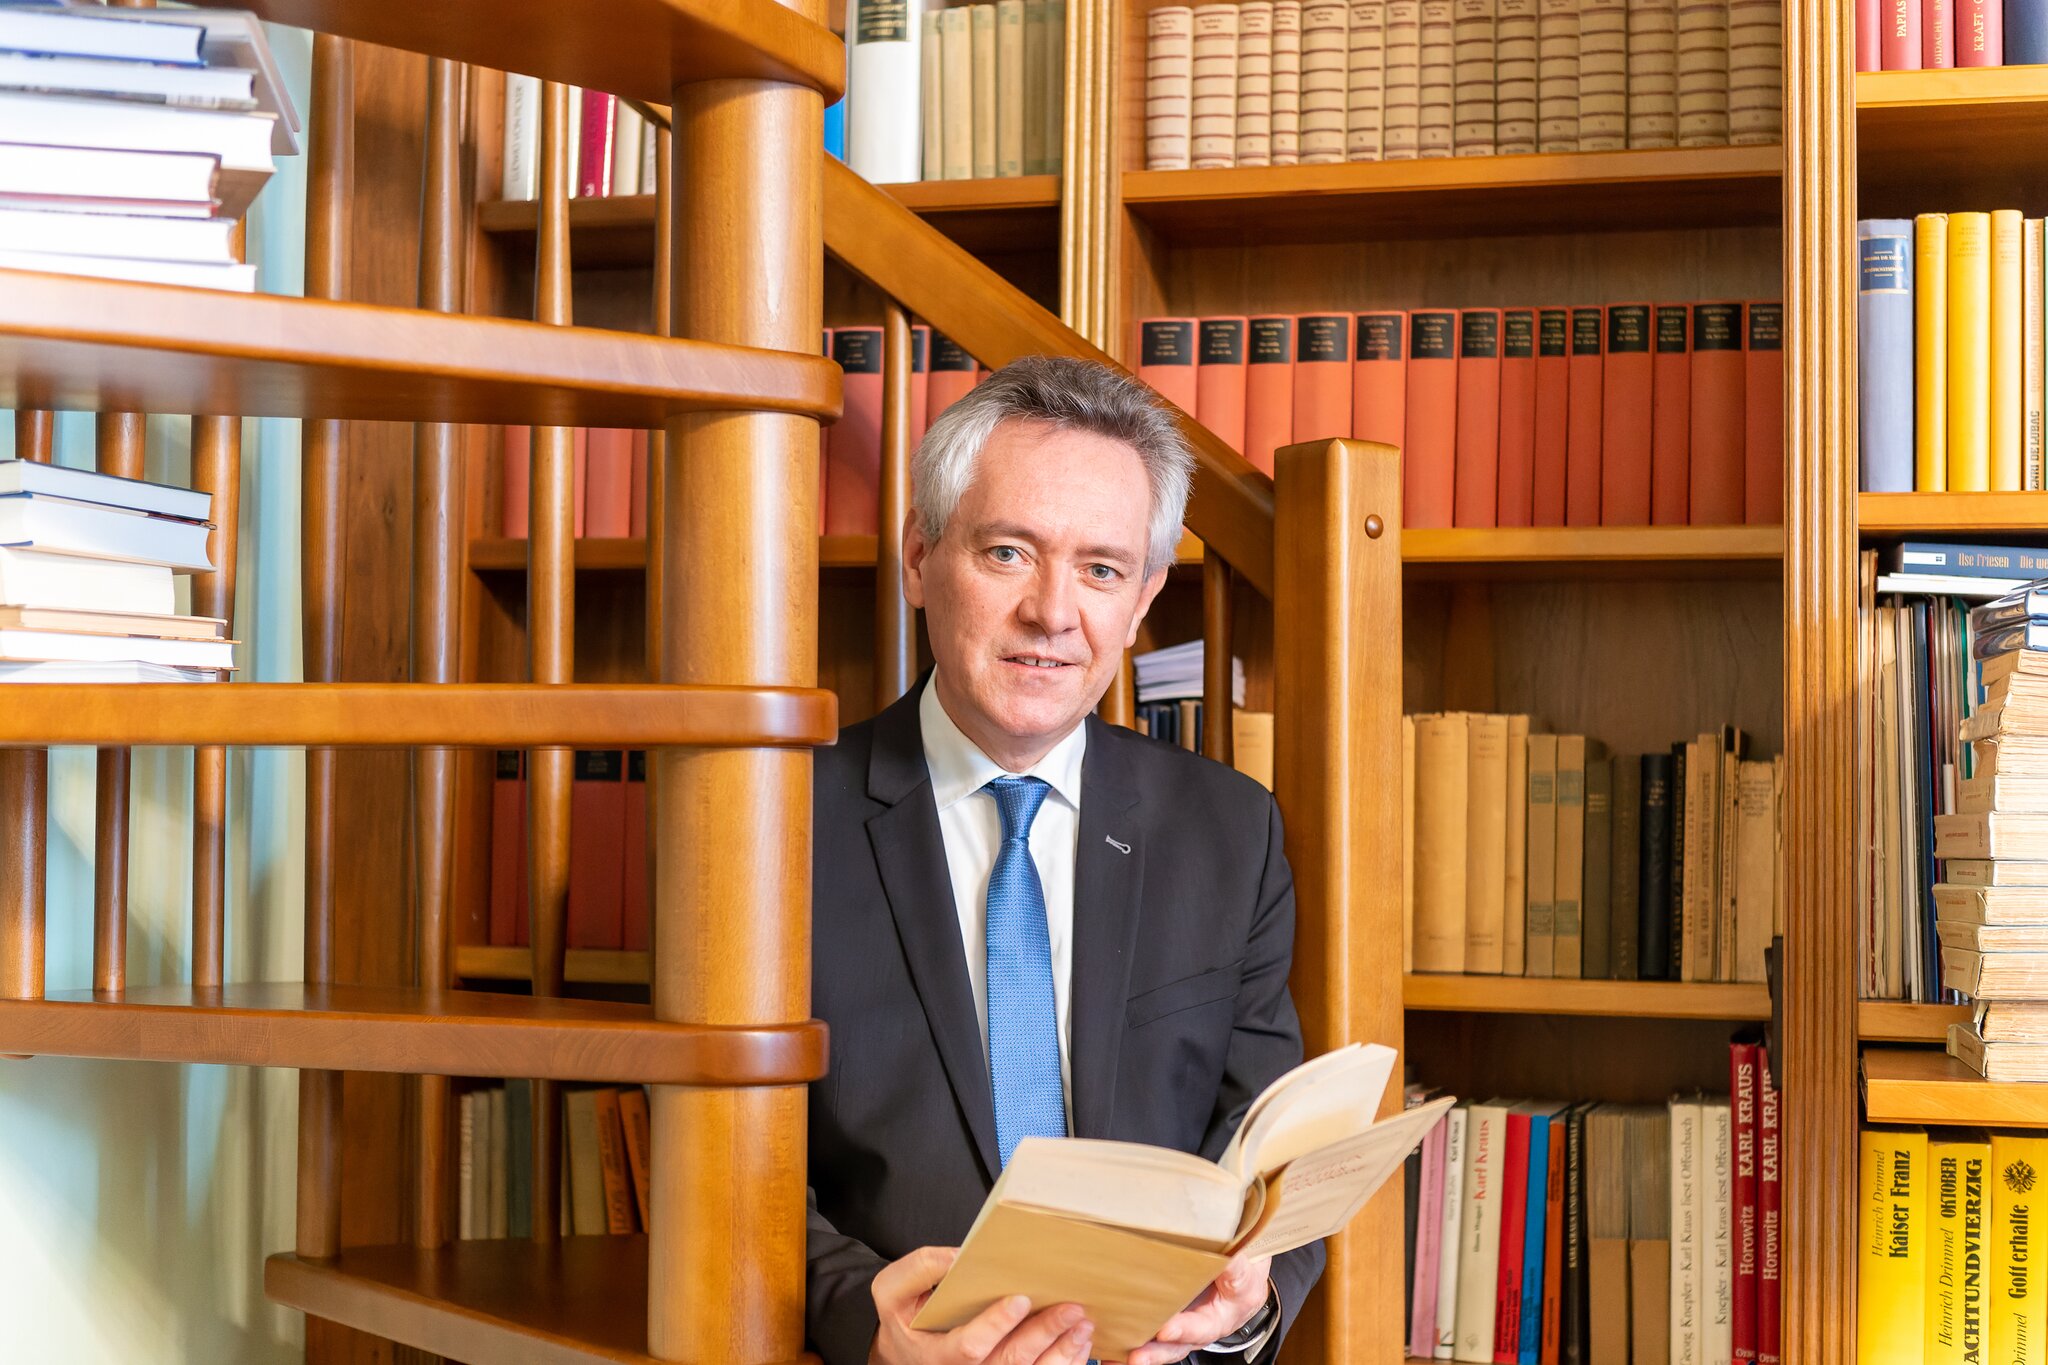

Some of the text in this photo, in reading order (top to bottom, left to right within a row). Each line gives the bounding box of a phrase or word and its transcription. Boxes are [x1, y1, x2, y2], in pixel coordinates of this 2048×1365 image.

[1896, 0, 1907, 37] PAPIAS
[1973, 12, 1984, 51] KRAFT
[1934, 21, 1943, 64] DIDACHE
[2030, 410, 2040, 446] LUBAC
[2030, 447, 2040, 461] DE
[1958, 552, 1974, 567] Ilse
[1976, 553, 2009, 569] Friesen
[2020, 555, 2034, 569] Die
[1475, 1119, 1489, 1164] Kraus
[1680, 1117, 1693, 1179] Offenbach
[1763, 1133, 1778, 1182] KARL
[1473, 1168, 1487, 1200] Karl
[1738, 1063, 1754, 1275] Horowitz KARL KRAUS
[1680, 1183, 1692, 1206] liest
[1871, 1149, 1885, 1258] Heinrich Drimmel
[1889, 1150, 1910, 1258] Kaiser Franz
[1680, 1210, 1692, 1243] Kraus
[1715, 1113, 1727, 1325] Knepler Karl Kraus liest Offenbach
[2009, 1204, 2029, 1263] erhalte
[1680, 1247, 1692, 1271] Karl
[1763, 1210, 1778, 1280] Horowitz
[1938, 1157, 1957, 1347] Heinrich Drimmel OKTOBER
[1963, 1158, 1983, 1365] ACHTUNDVIERZIG
[1680, 1280, 1693, 1327] Knepler
[2008, 1264, 2028, 1299] Gott
